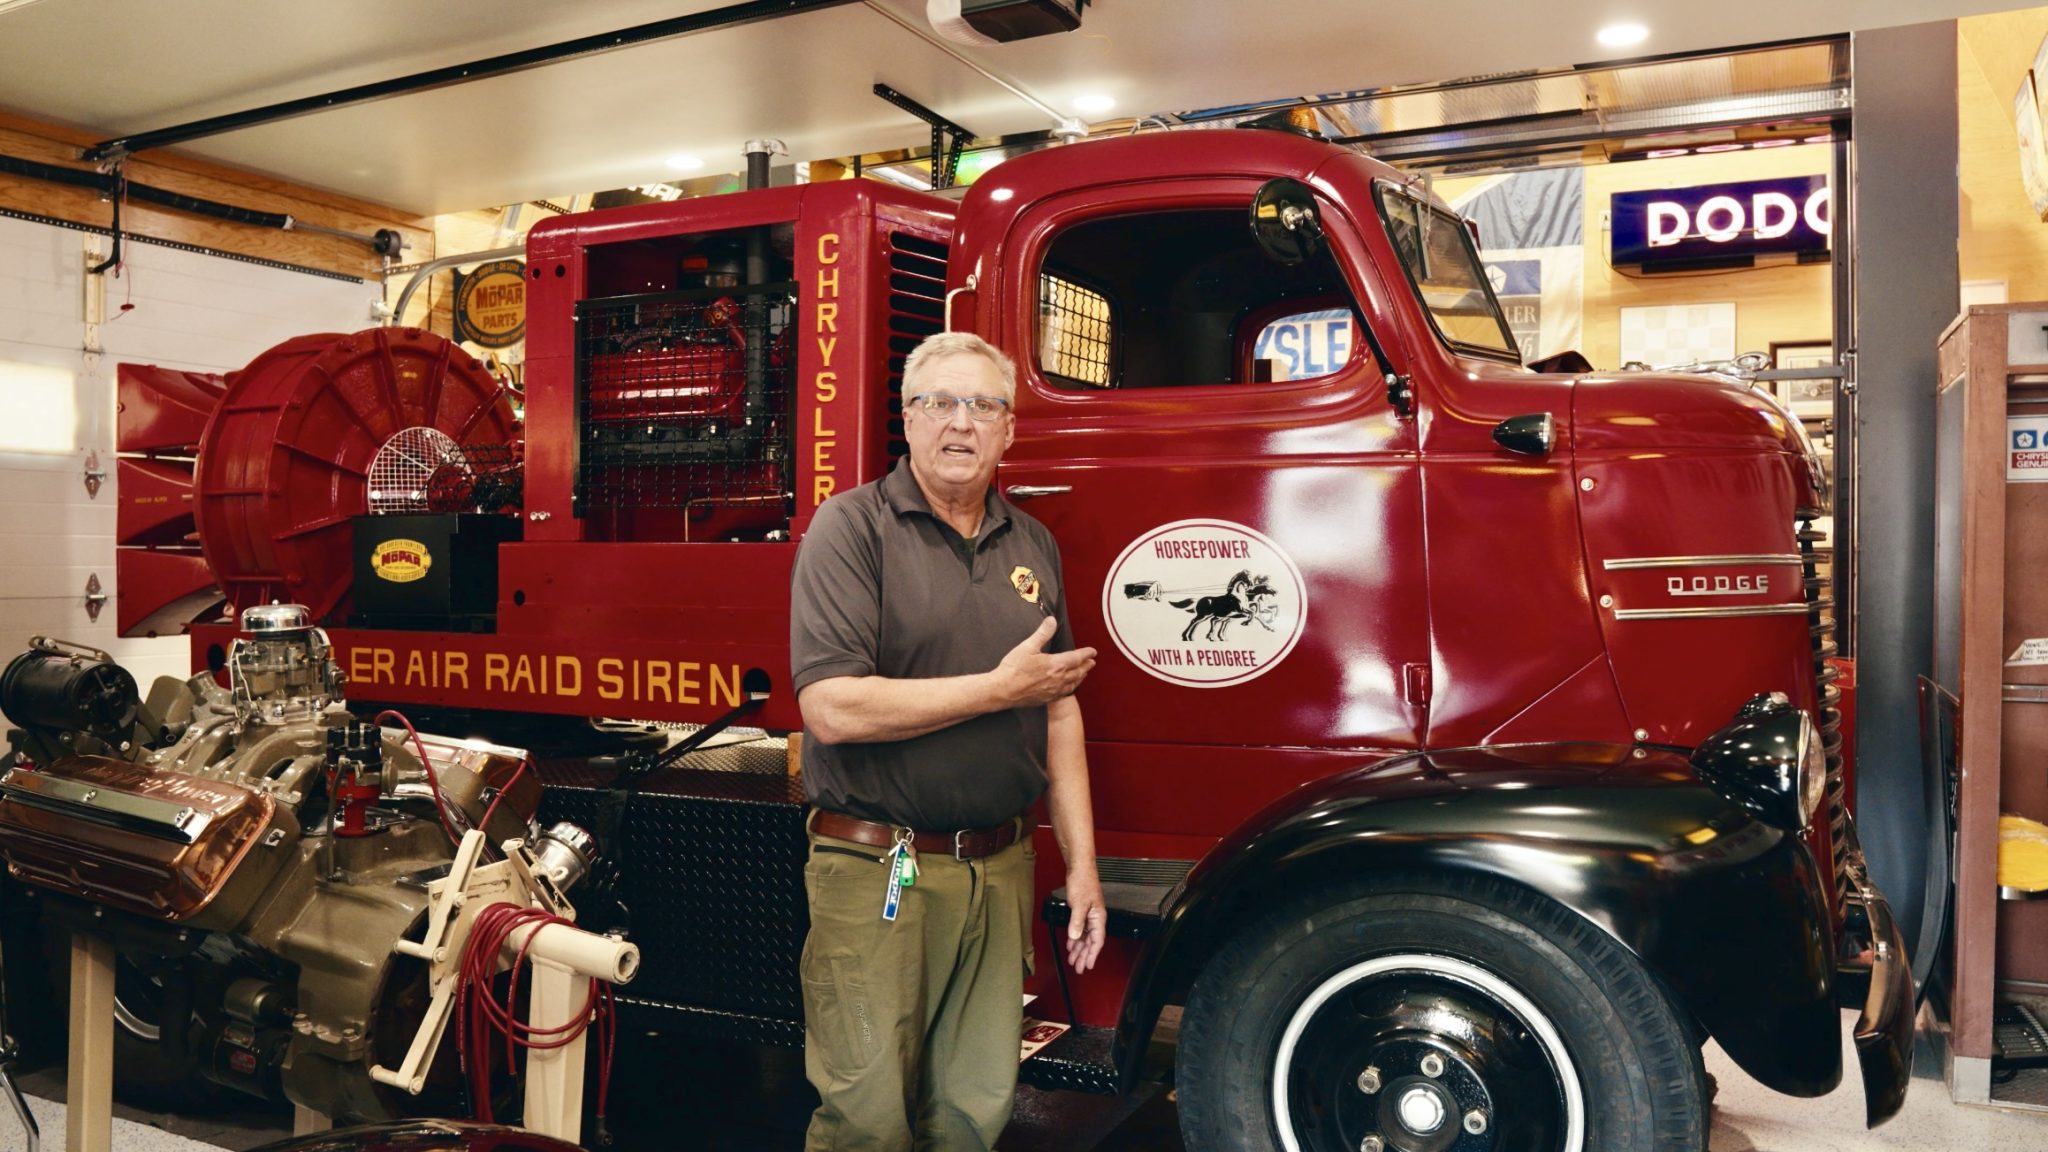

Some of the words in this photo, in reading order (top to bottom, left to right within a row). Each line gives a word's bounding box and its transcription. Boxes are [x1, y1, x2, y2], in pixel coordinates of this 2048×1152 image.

[482, 313, 518, 330] PARTS
[1505, 306, 1537, 324] LER
[814, 233, 840, 506] CHRYSLER
[1154, 540, 1251, 559] HORSEPOWER
[1667, 575, 1768, 594] DODGE
[1148, 649, 1183, 666] WITH
[1186, 650, 1196, 666] A
[1199, 650, 1259, 667] PEDIGREE
[405, 650, 469, 689] AIR
[485, 653, 582, 697] RAID
[598, 658, 741, 707] SIREN
